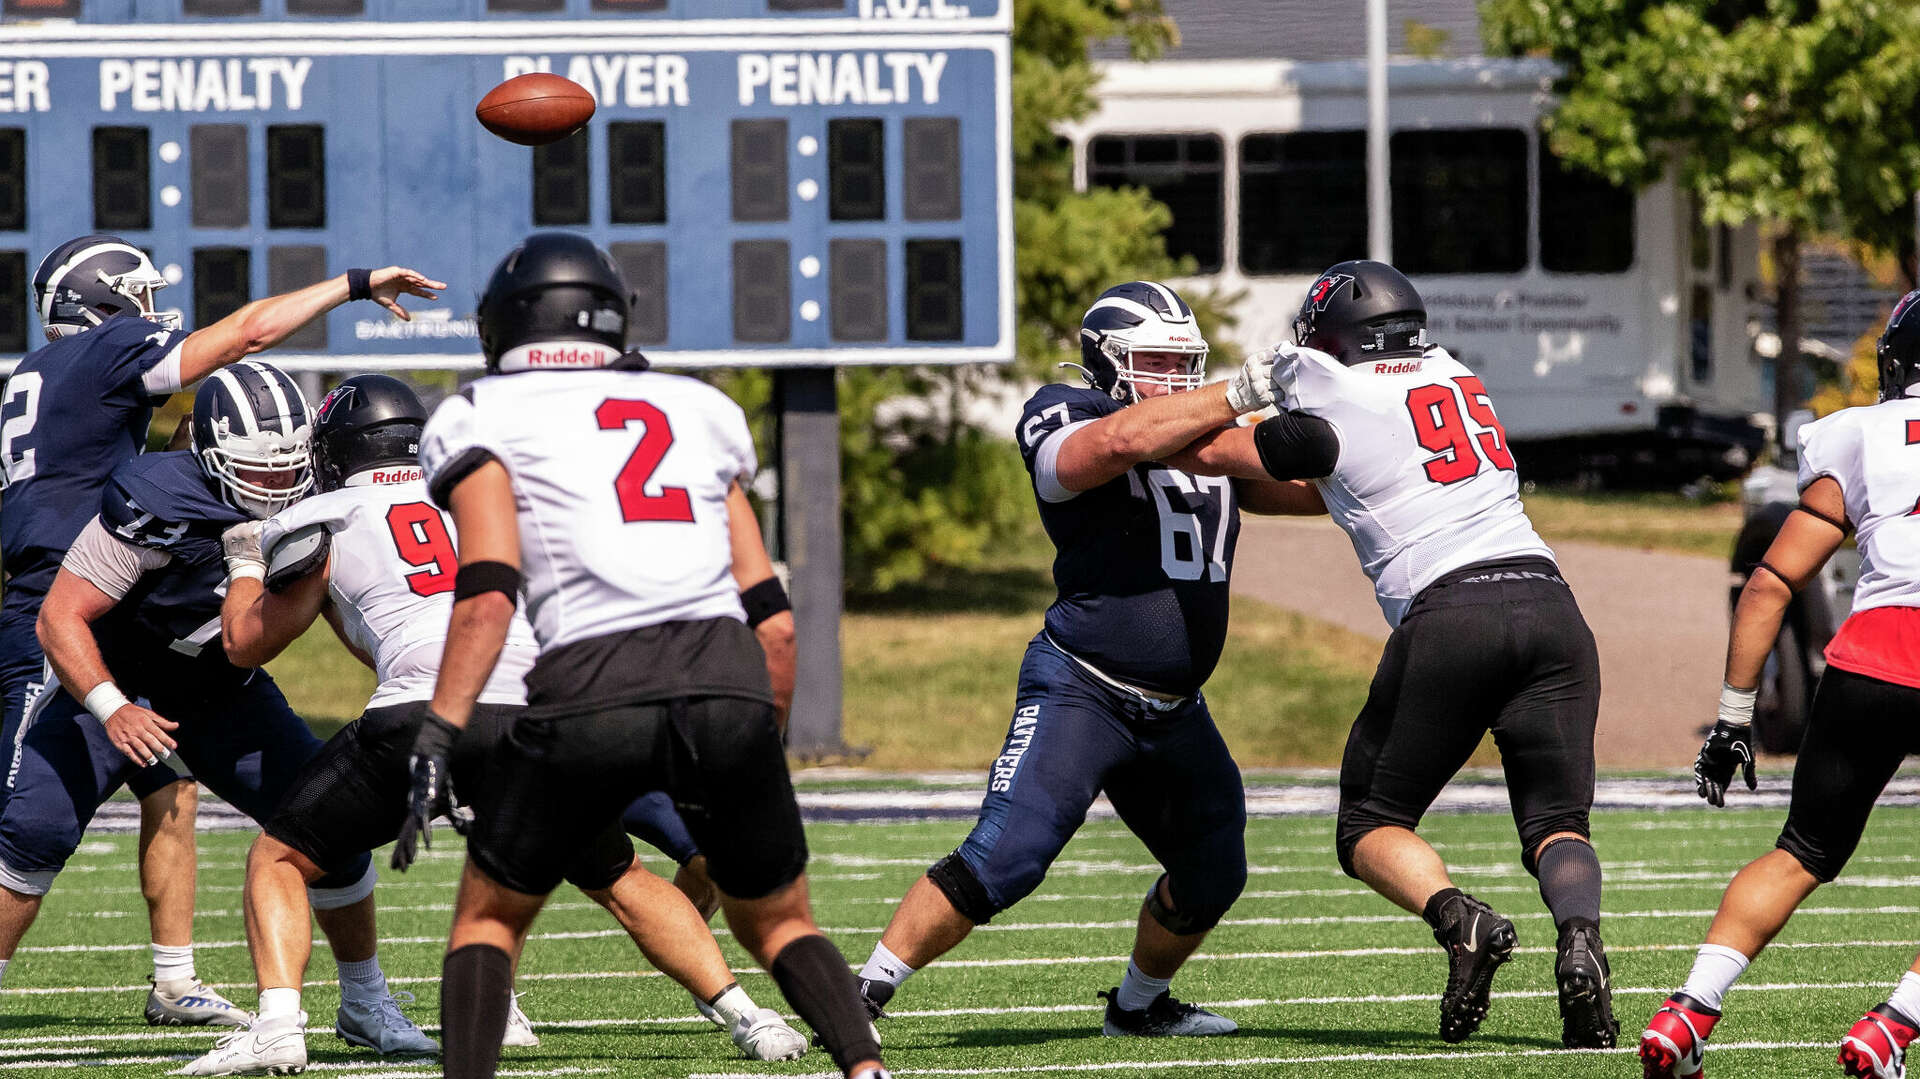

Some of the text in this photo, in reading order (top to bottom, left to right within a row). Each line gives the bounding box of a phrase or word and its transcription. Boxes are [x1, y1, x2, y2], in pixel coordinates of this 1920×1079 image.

[100, 59, 312, 111] PENALTY
[503, 54, 689, 107] AYER
[738, 52, 948, 105] PENALTY
[529, 349, 605, 368] Riddell
[1375, 361, 1423, 375] Riddell
[0, 371, 43, 491] 2
[1405, 376, 1516, 487] 95
[594, 397, 697, 525] 2
[1148, 468, 1231, 583] 67
